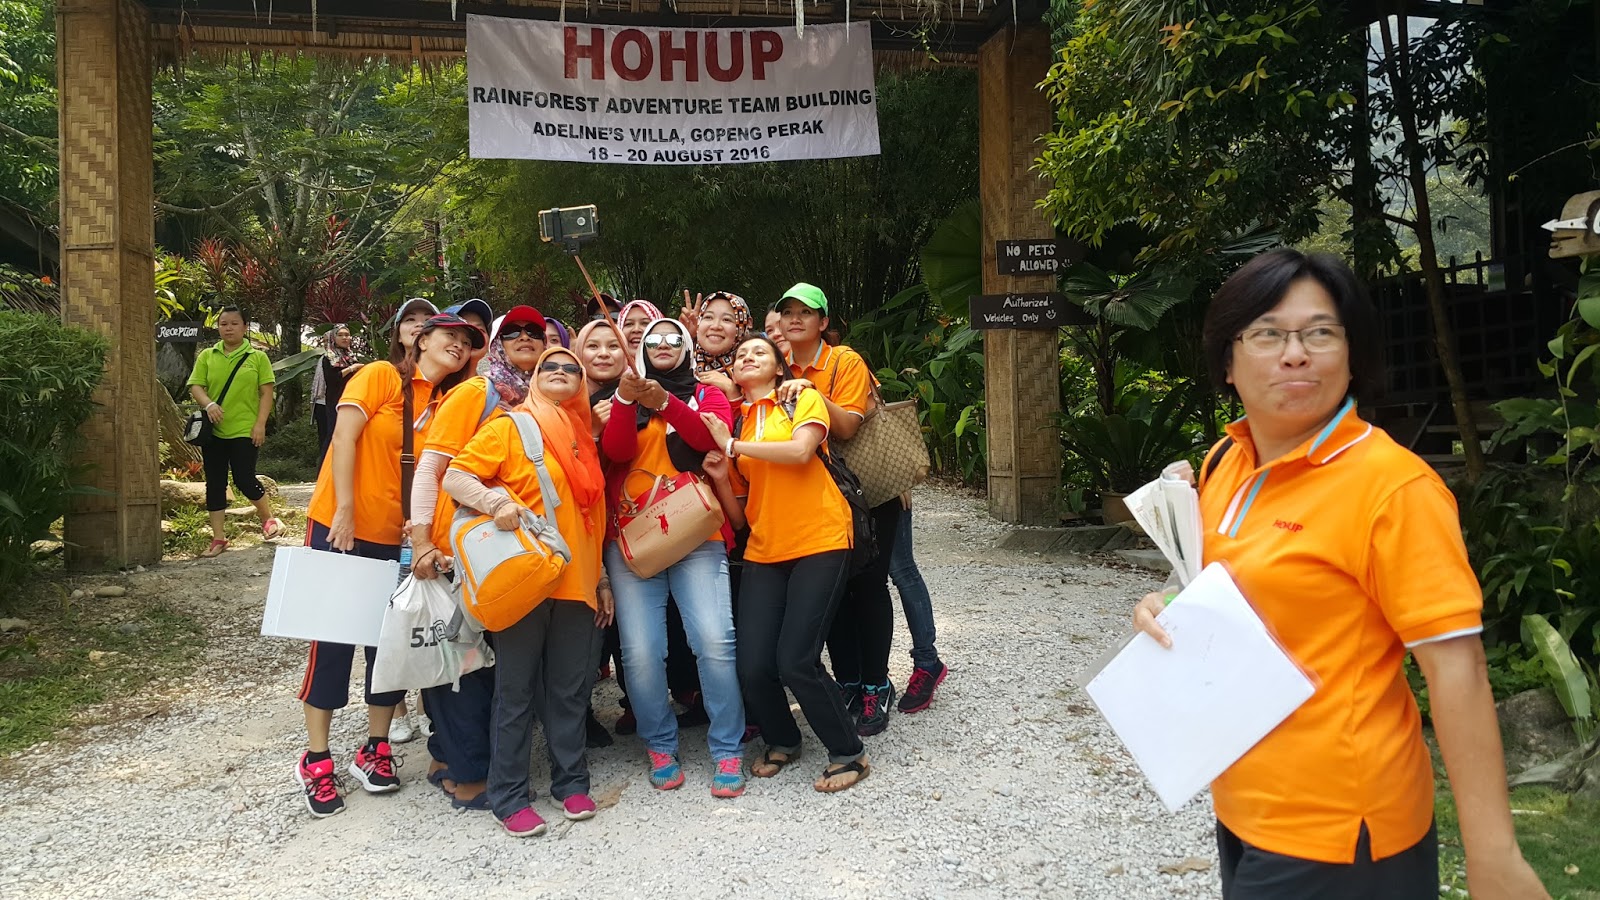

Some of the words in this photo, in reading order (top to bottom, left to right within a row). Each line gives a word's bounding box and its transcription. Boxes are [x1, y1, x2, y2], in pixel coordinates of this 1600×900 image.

[564, 26, 783, 82] HOHUP
[473, 87, 599, 113] RAINFOREST
[605, 97, 723, 114] ADVENTURE
[728, 97, 780, 113] TEAM
[786, 89, 872, 112] BUILDING
[533, 122, 624, 141] ADELINE'S
[629, 128, 685, 145] VILLA,
[690, 127, 762, 142] GOPENG
[767, 120, 824, 138] PERAK
[588, 147, 609, 160] 18
[627, 149, 647, 162] 20
[653, 149, 724, 163] AUGUST
[730, 146, 770, 160] 2016
[1006, 245, 1021, 257] NO
[1029, 244, 1056, 256] PETS
[1019, 259, 1059, 272] ALLOWED
[1002, 296, 1049, 309] Authorized
[983, 313, 1014, 323] Vehicles
[1022, 313, 1039, 323] Only
